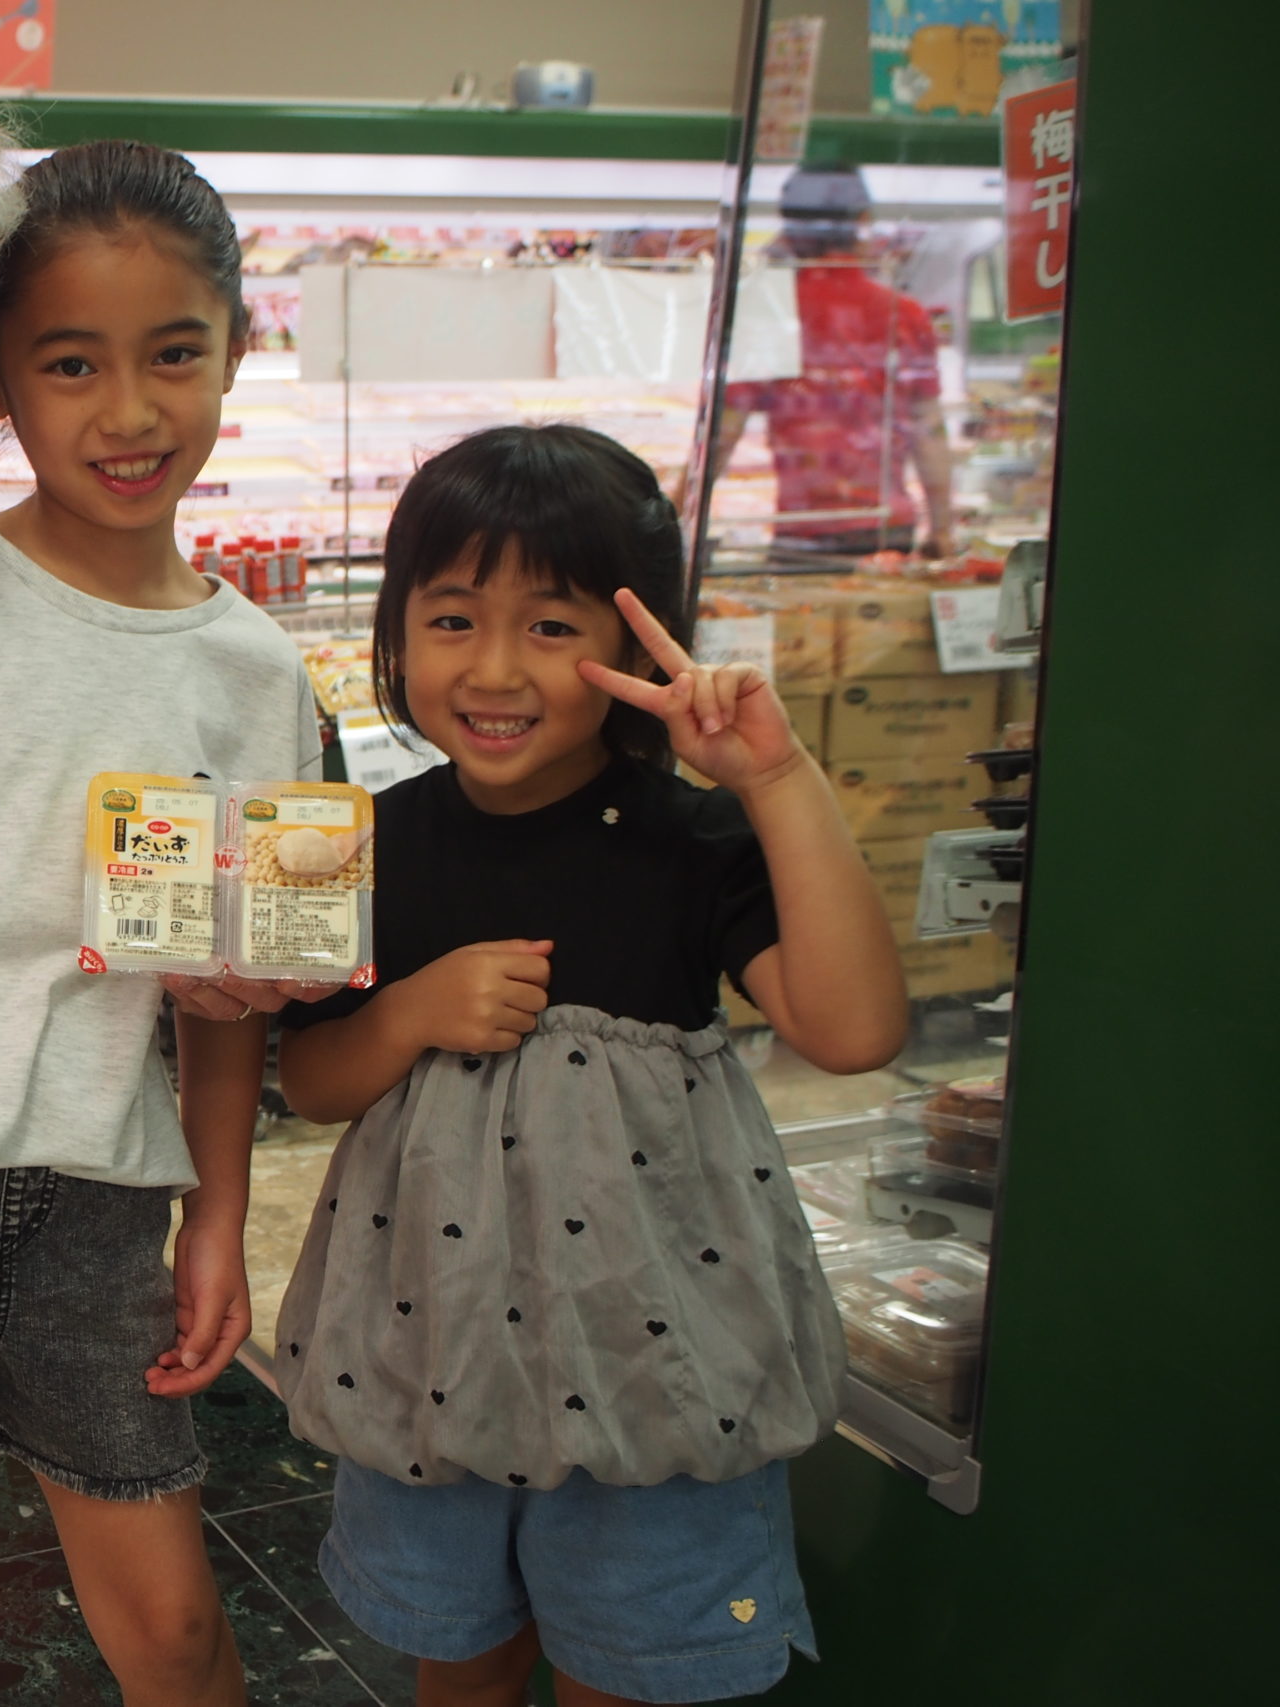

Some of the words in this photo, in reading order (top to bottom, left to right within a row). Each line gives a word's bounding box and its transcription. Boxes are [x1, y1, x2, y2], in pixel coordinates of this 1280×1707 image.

[1030, 108, 1075, 289] 梅干し
[131, 834, 190, 853] だいず
[132, 853, 188, 864] たっぷりとうふ
